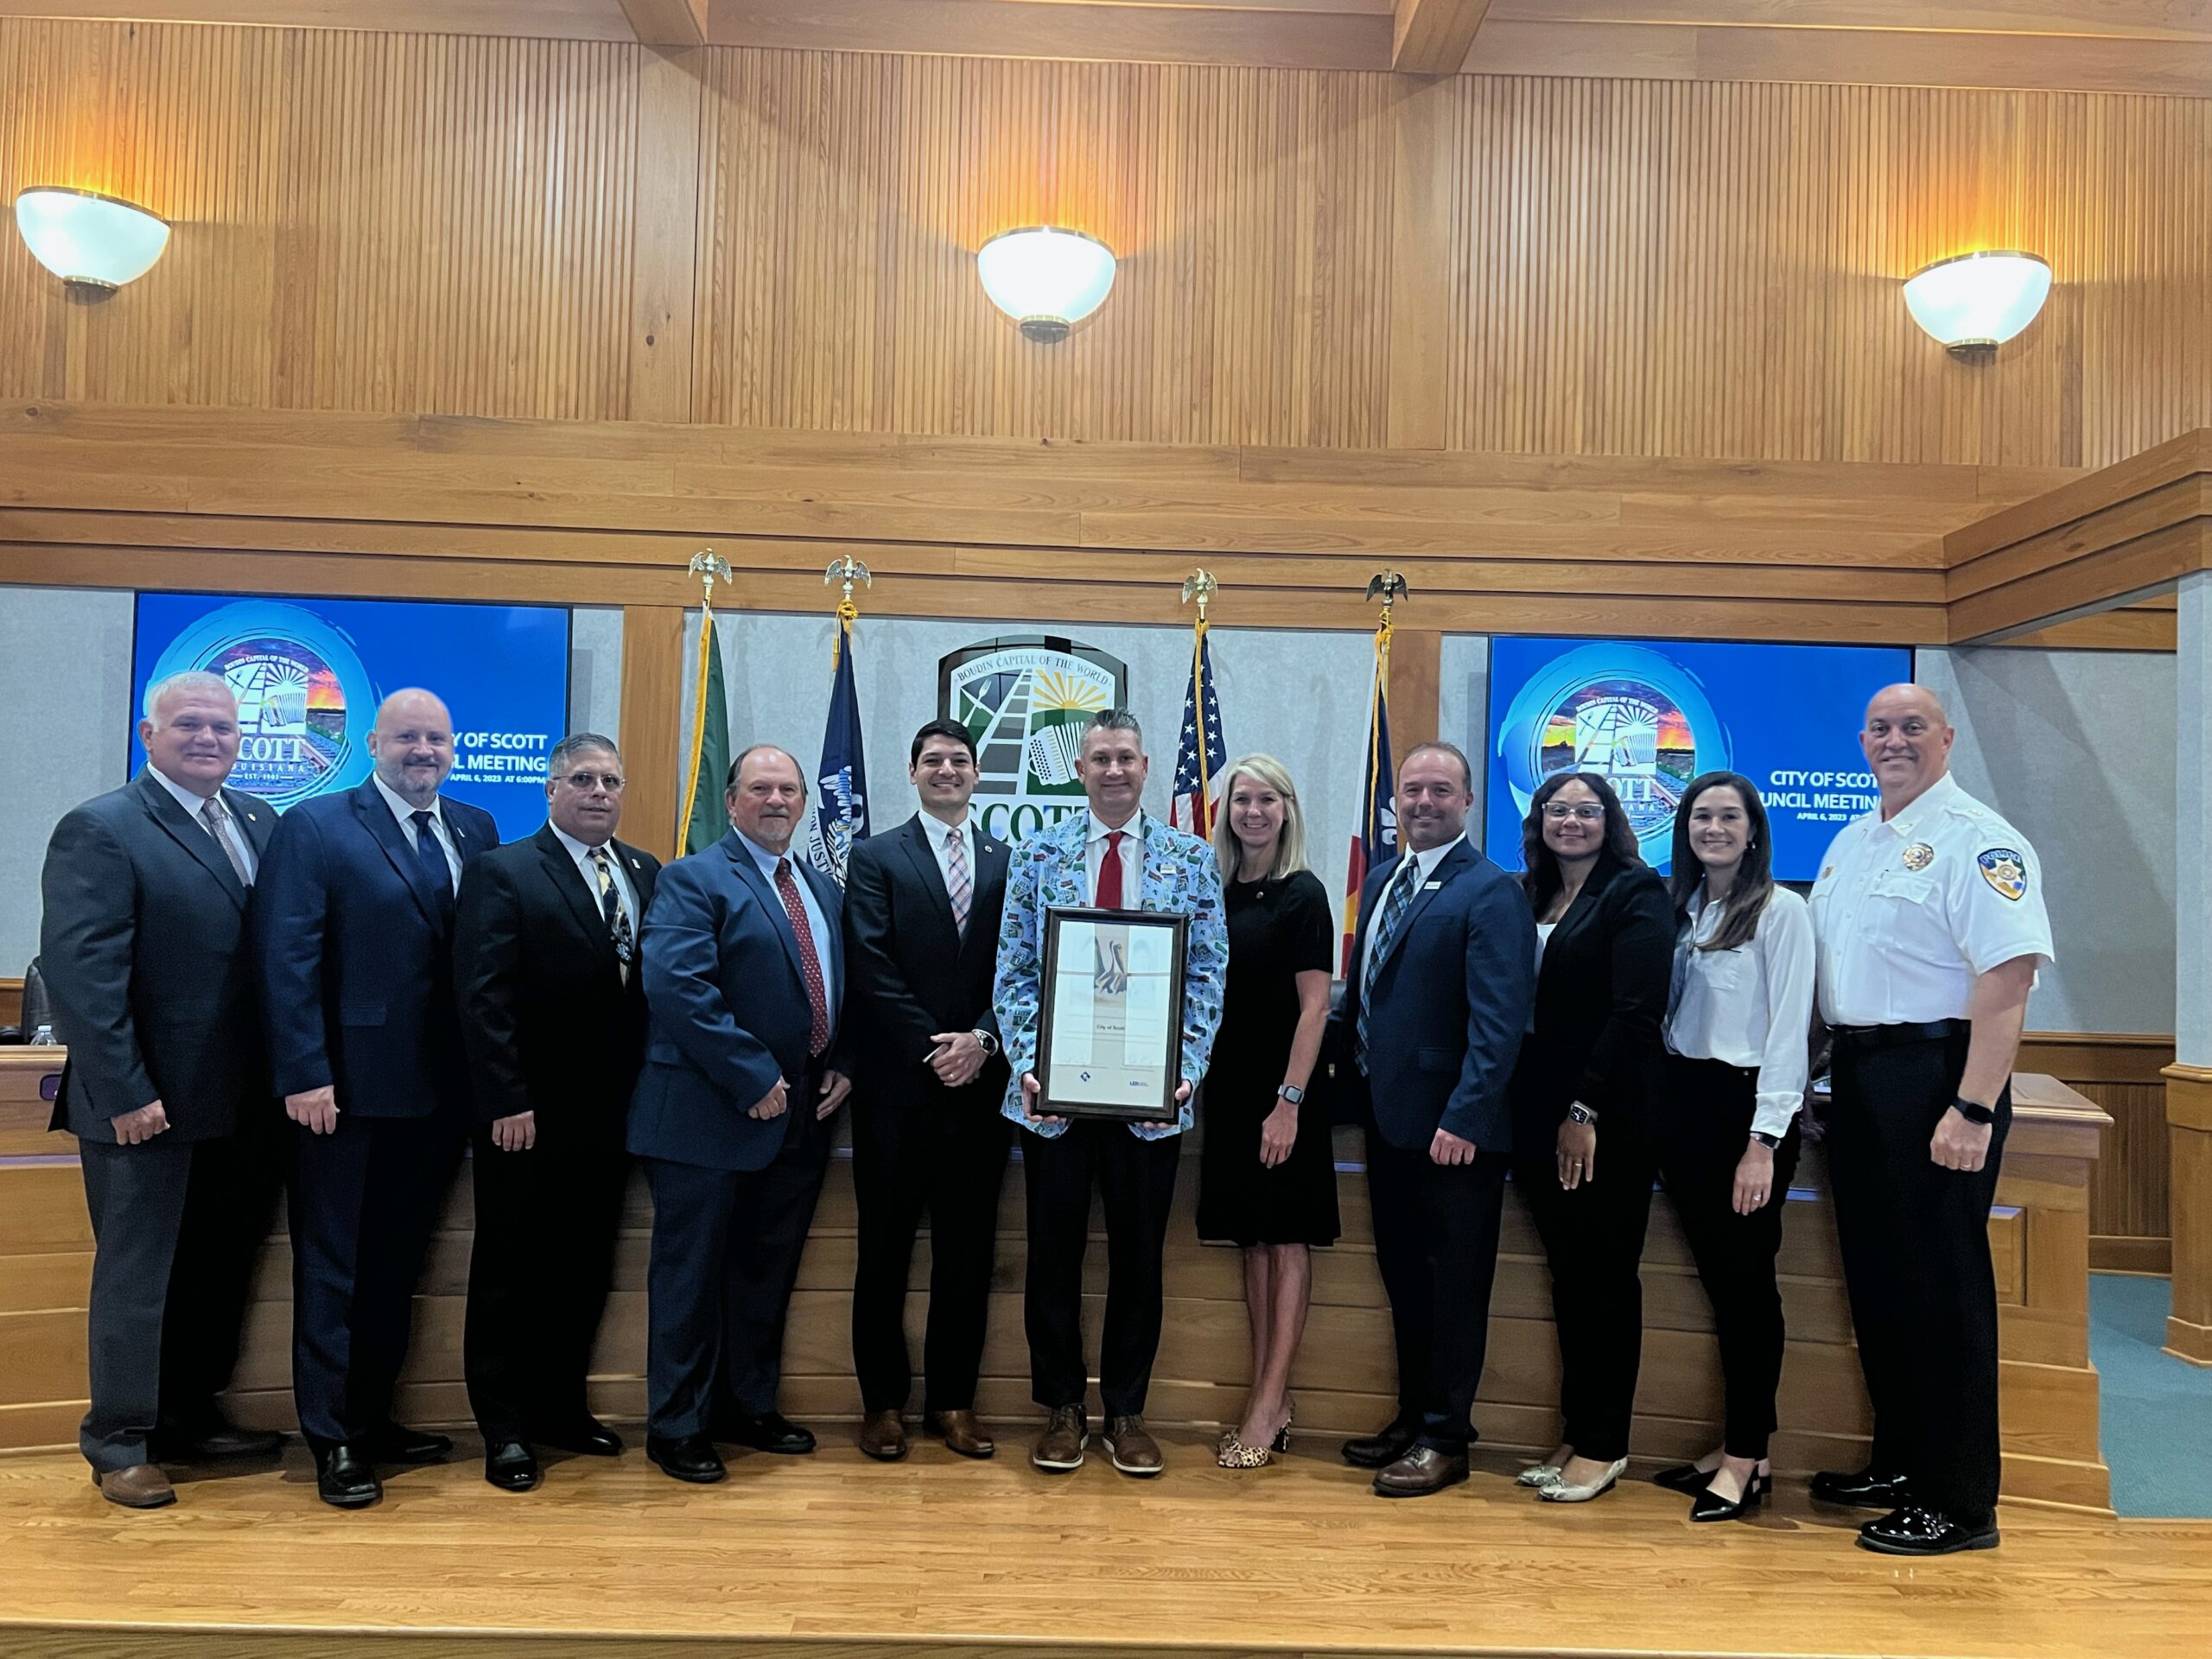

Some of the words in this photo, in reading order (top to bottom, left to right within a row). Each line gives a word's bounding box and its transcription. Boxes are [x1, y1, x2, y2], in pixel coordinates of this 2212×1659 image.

[957, 658, 994, 681] BOUDIN
[996, 655, 1036, 667] CAPITAL
[1039, 656, 1051, 665] OF
[1055, 657, 1073, 670] THE
[1077, 663, 1109, 685] WORLD
[238, 736, 306, 762] COTT
[464, 732, 489, 748] OF
[490, 733, 548, 750] SCOTT
[467, 754, 547, 772] MEETING
[450, 773, 473, 782] APRIL
[474, 774, 481, 783] 6,
[483, 774, 502, 783] 2023
[516, 775, 546, 785] 6:00PM
[1770, 771, 1809, 786] CITY
[1810, 772, 1834, 787] OF
[1834, 772, 1878, 789] SCOT
[1759, 791, 1811, 808] UNCIL
[1814, 793, 1878, 810] MEETIN
[1796, 812, 1819, 821] APRIL
[1820, 813, 1827, 822] 6,
[1828, 813, 1847, 822] 2023
[1980, 850, 2022, 864] POLICE
